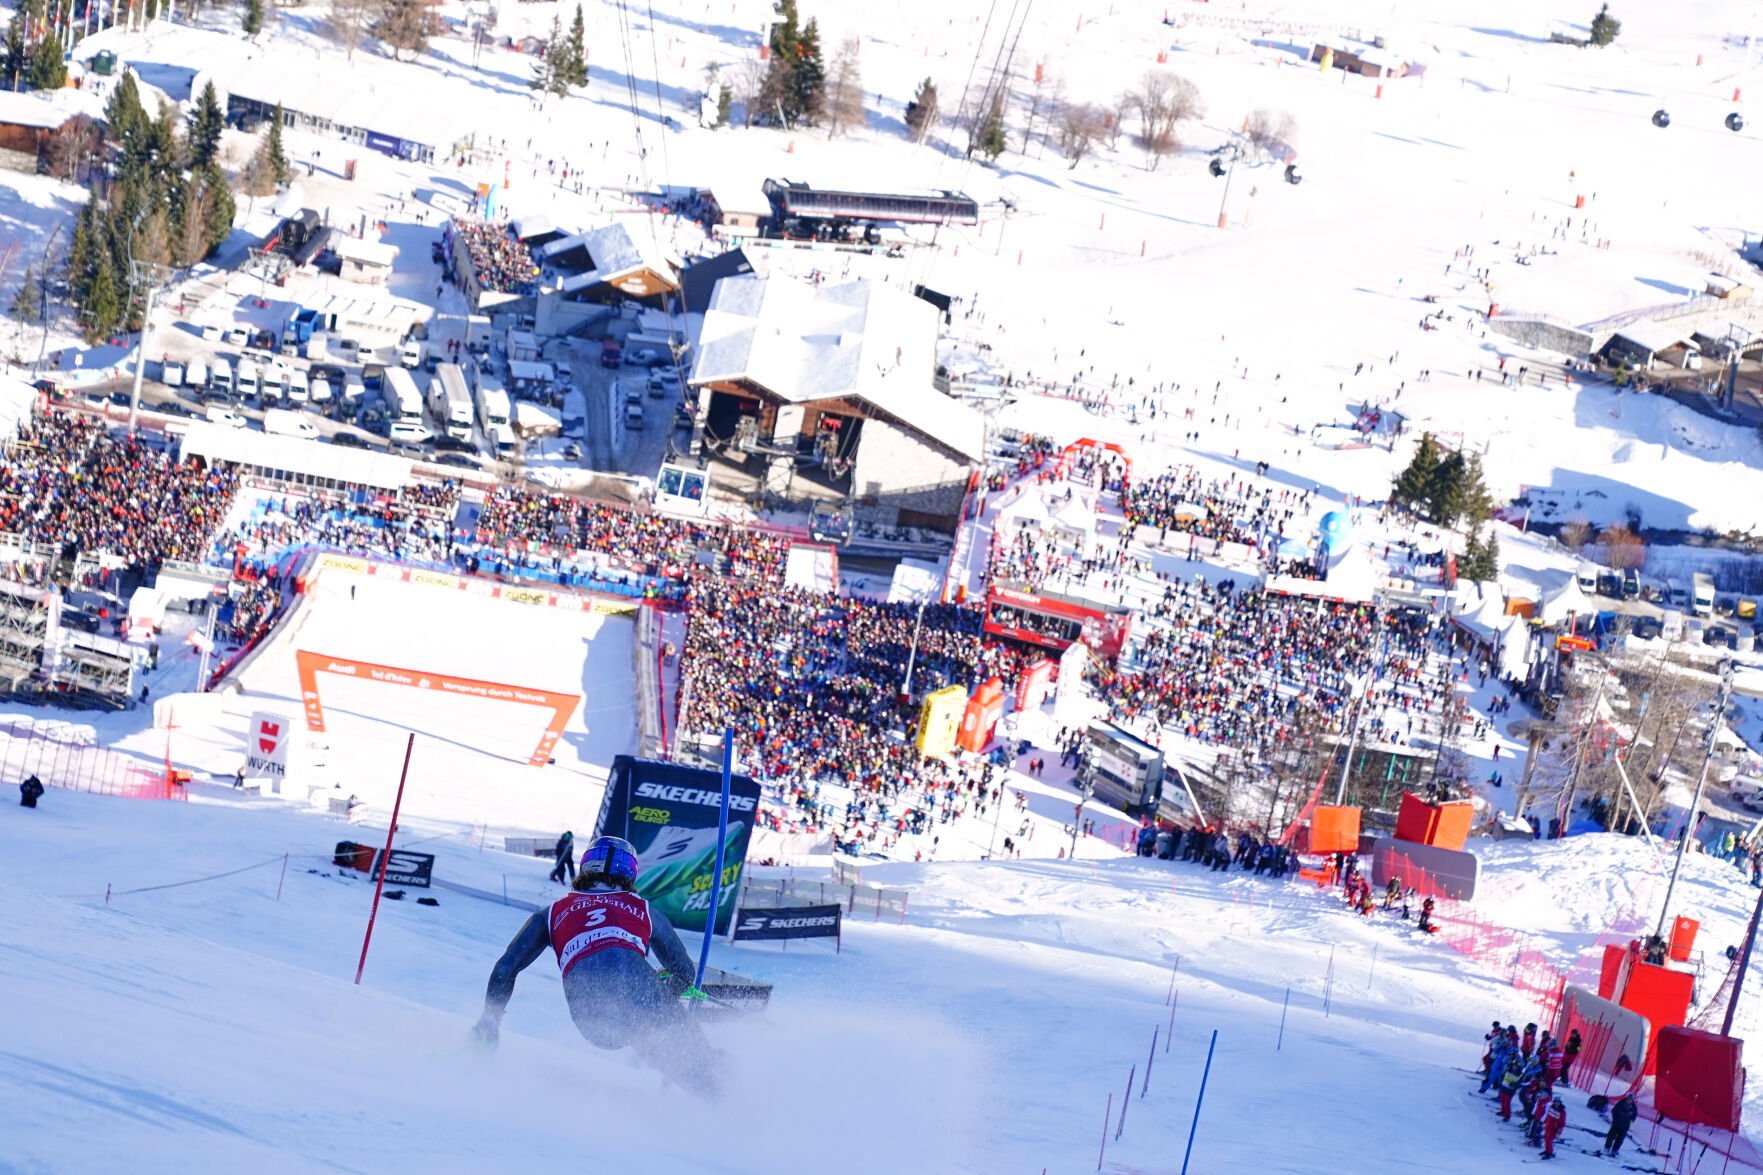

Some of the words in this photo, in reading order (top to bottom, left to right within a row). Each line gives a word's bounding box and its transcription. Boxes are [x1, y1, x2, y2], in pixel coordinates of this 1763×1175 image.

[327, 662, 356, 674] Audi
[634, 782, 756, 812] SKECHERS
[629, 806, 671, 819] AERO
[633, 814, 671, 825] BURST
[688, 861, 742, 894] SCRY
[570, 899, 645, 920] GENERALI
[584, 907, 607, 927] 3
[769, 915, 837, 929] SKECHERS
